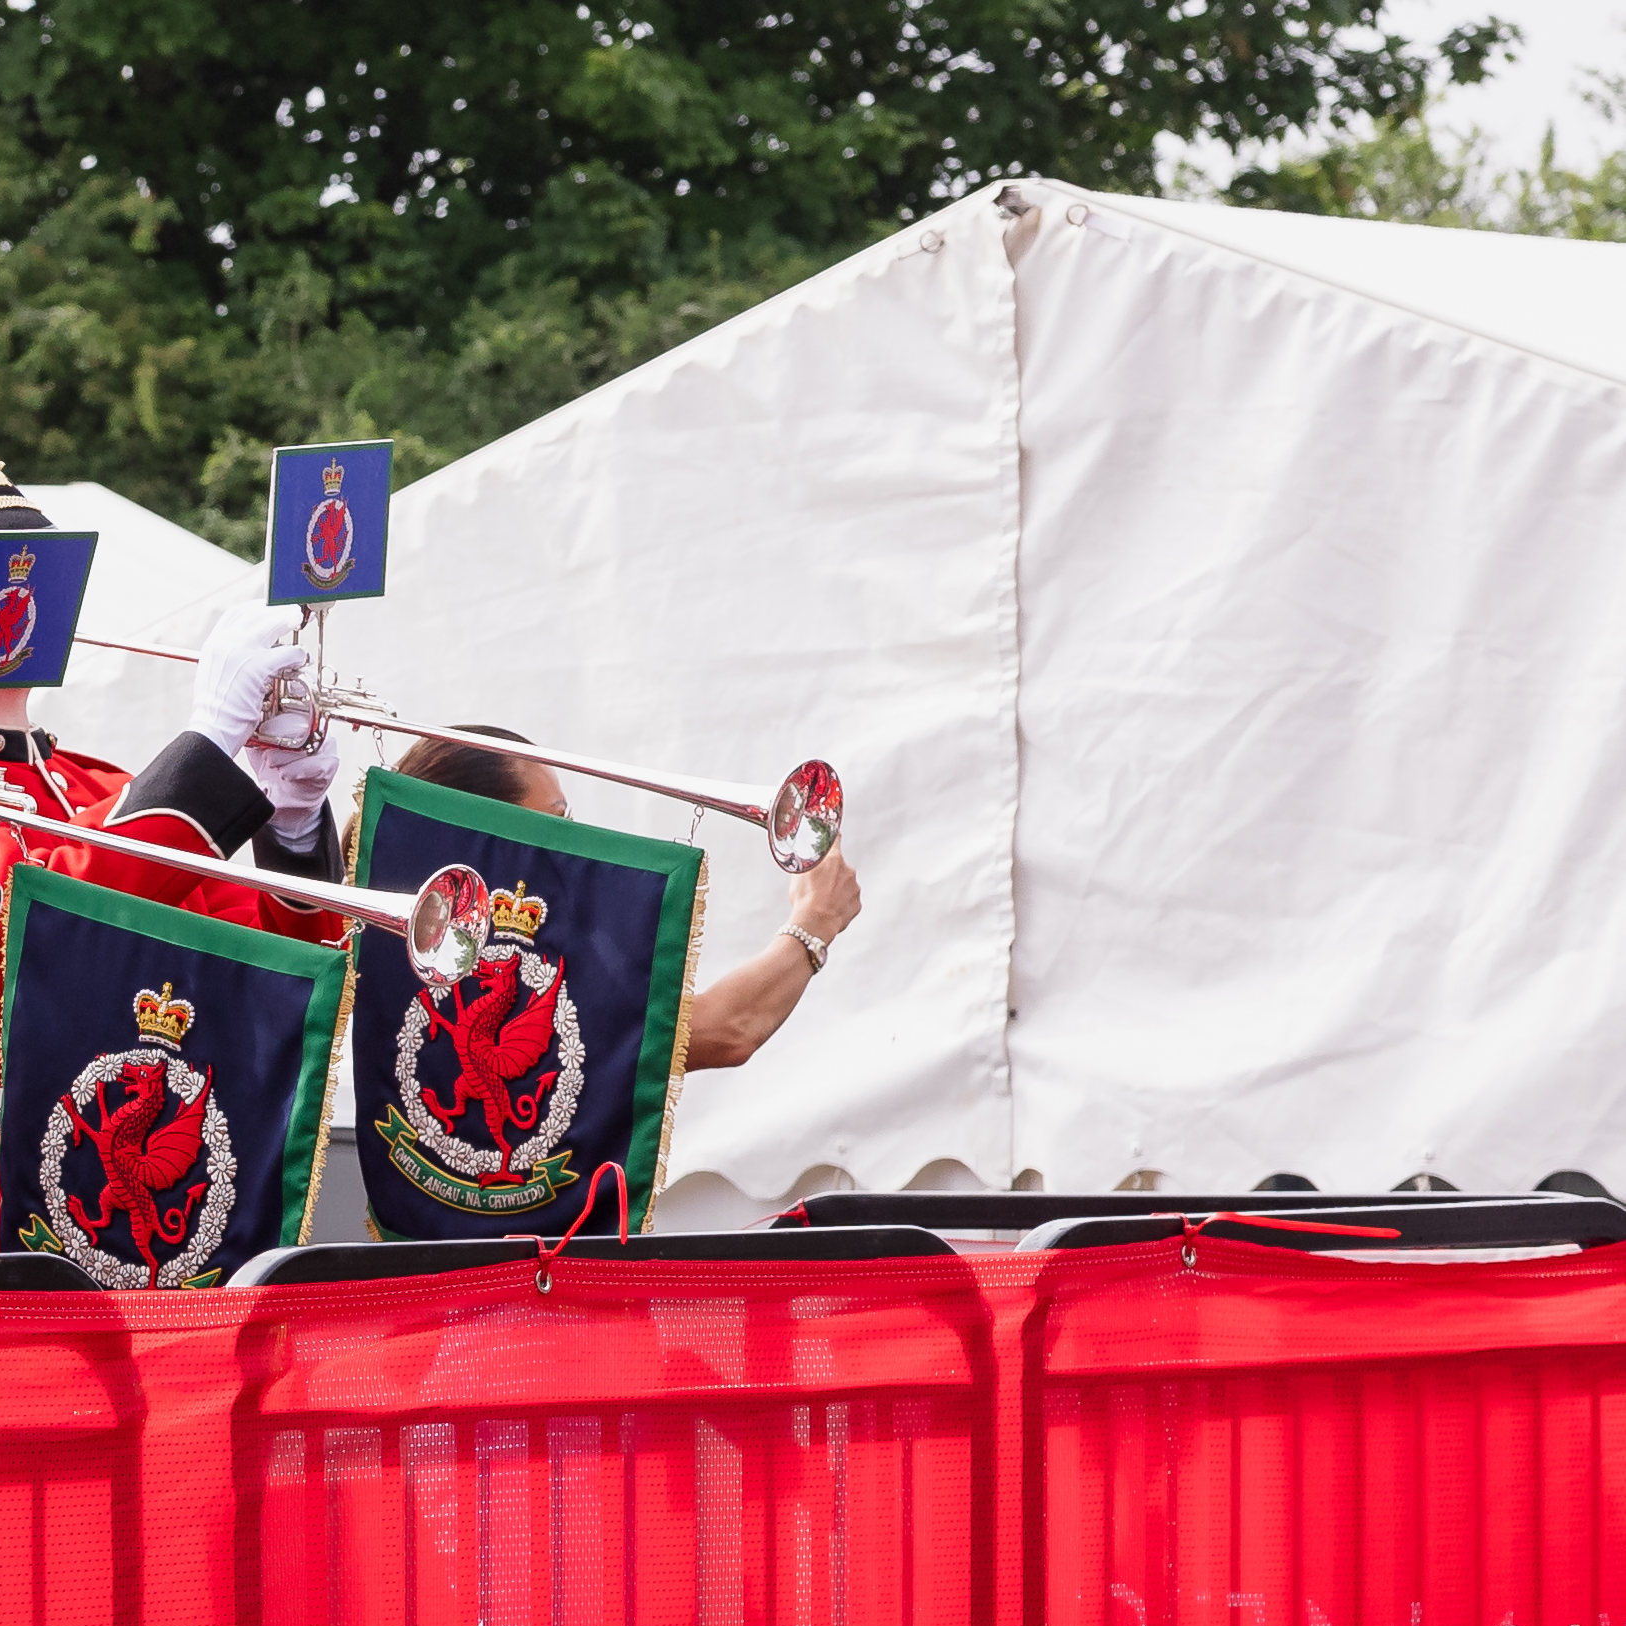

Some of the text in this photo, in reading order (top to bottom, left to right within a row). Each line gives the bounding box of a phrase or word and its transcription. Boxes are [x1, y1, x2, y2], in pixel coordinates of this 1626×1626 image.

[394, 1147, 420, 1180] GWELL
[423, 1175, 461, 1201] ANGAU
[465, 1191, 482, 1208] NA
